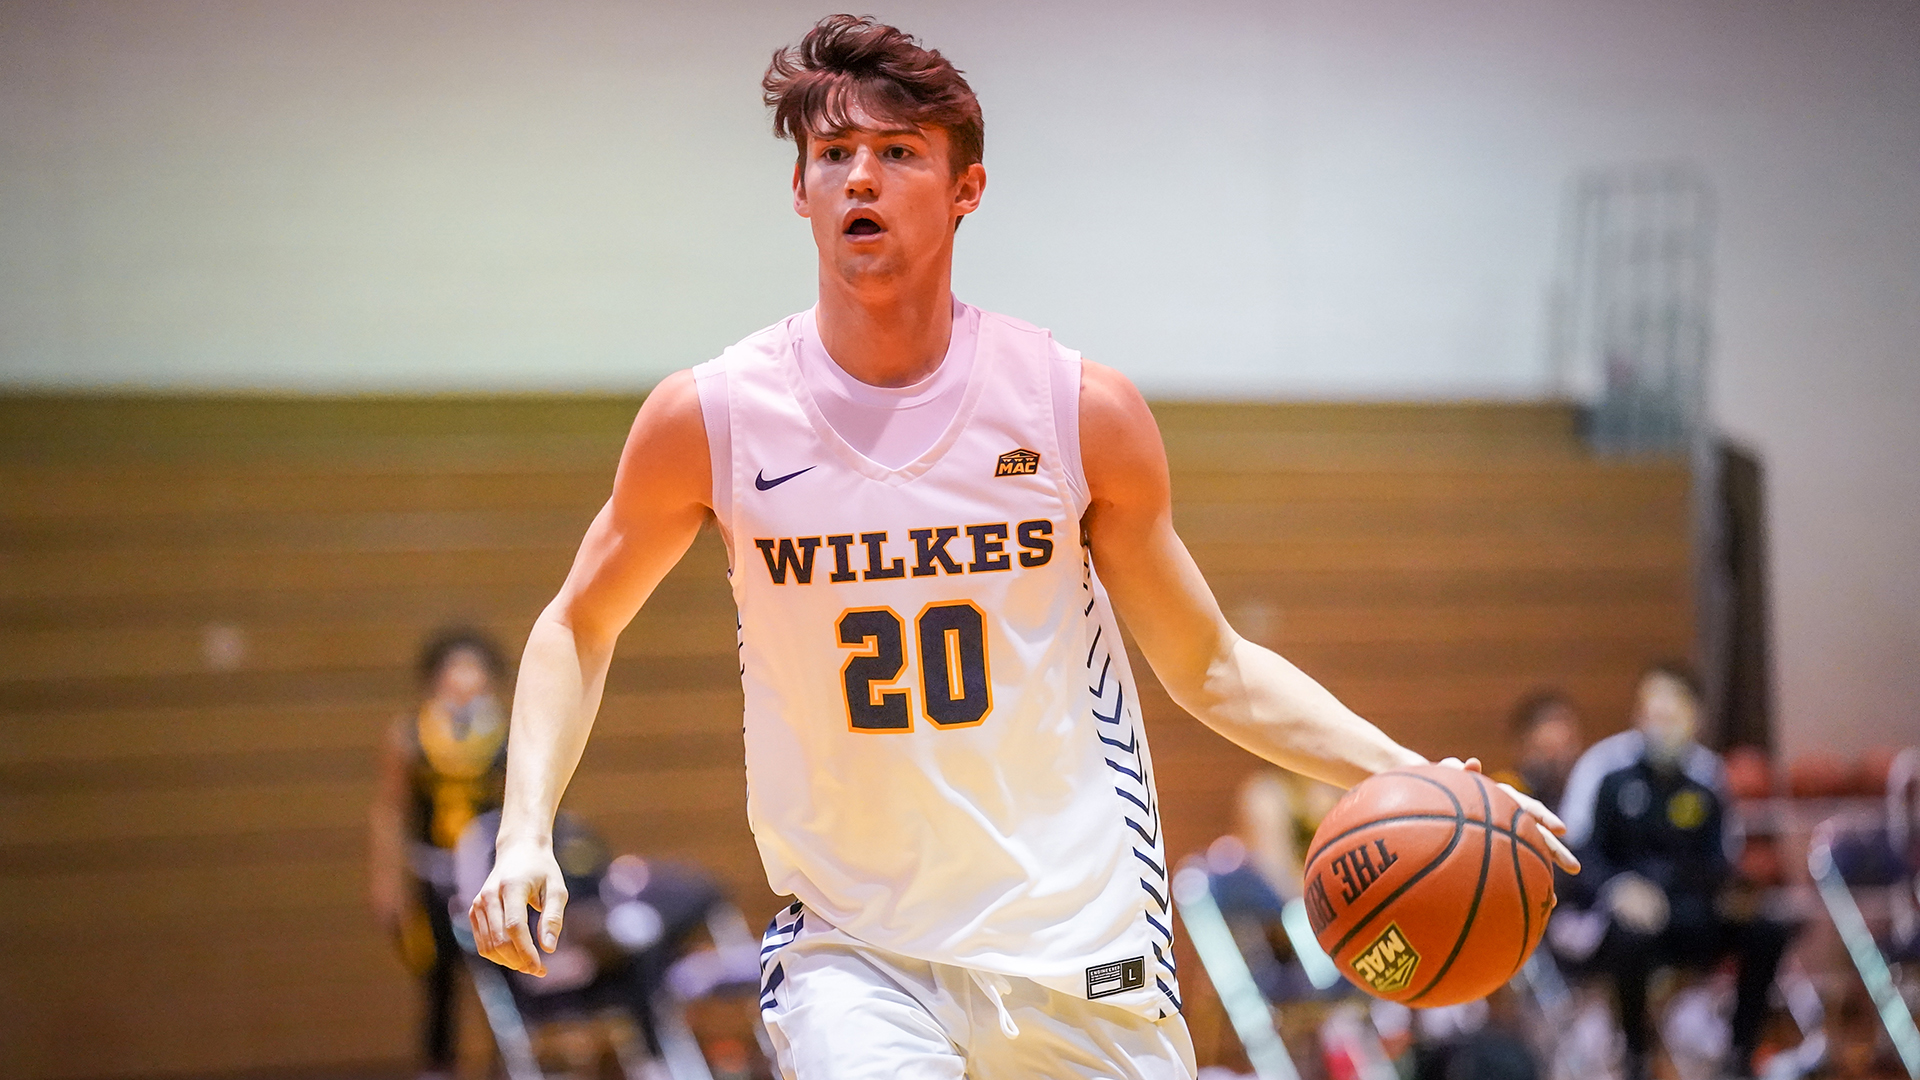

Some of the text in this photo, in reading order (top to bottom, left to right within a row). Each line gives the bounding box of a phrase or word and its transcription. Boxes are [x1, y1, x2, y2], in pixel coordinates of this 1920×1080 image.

[998, 461, 1036, 475] MAC
[753, 517, 1055, 586] WILKES
[834, 599, 993, 734] 20
[1330, 839, 1399, 905] THE
[1128, 968, 1137, 981] L
[1355, 929, 1406, 982] MAC
